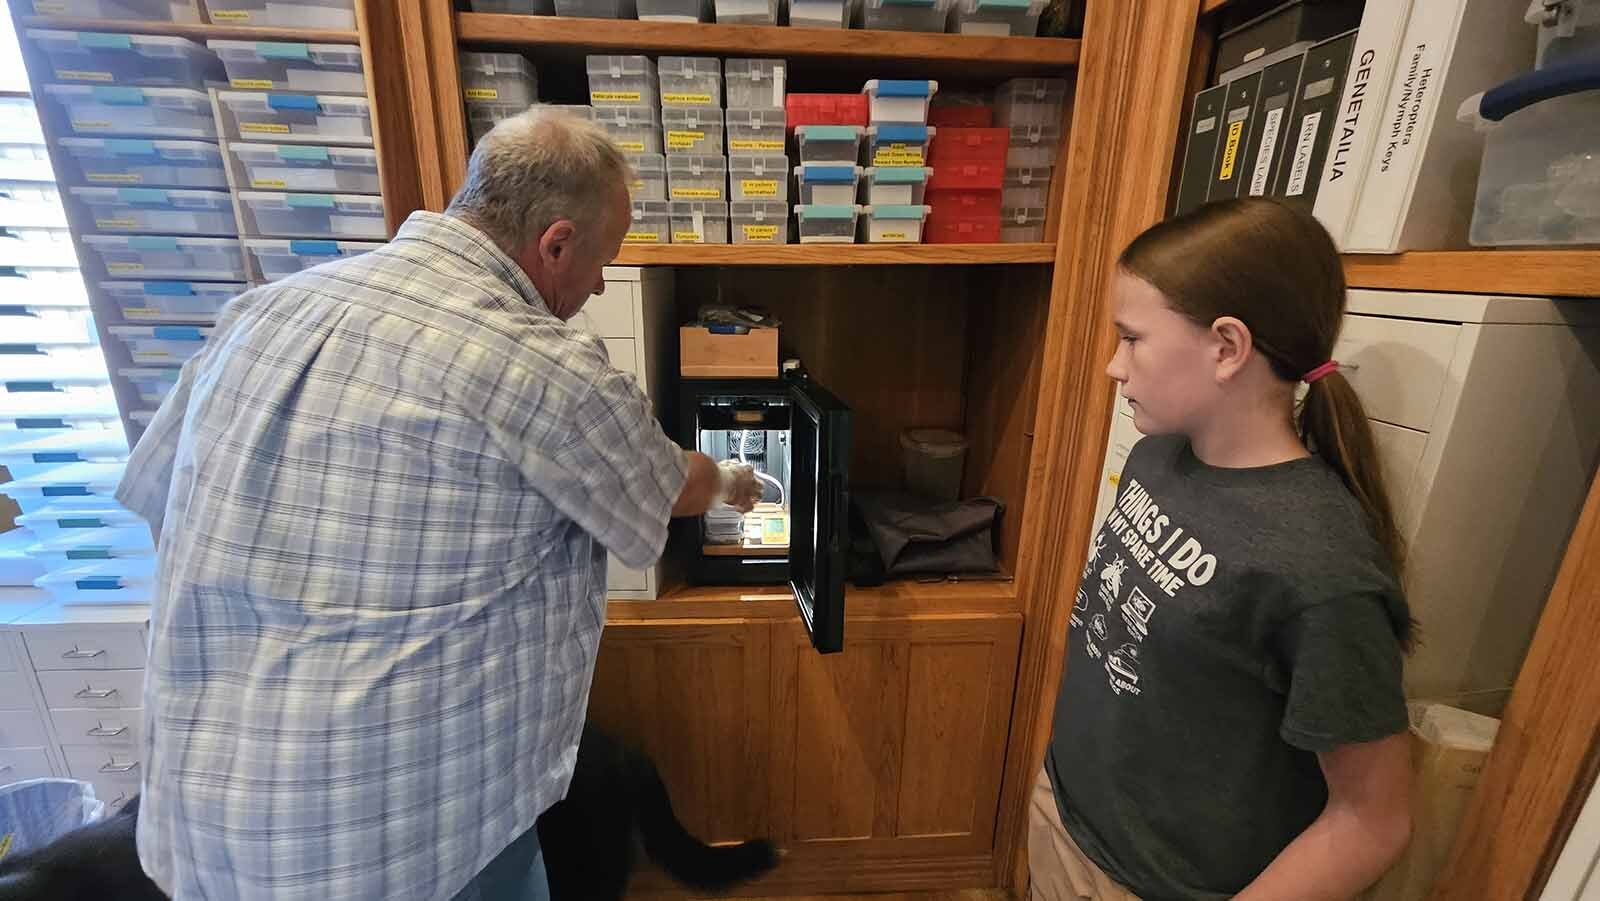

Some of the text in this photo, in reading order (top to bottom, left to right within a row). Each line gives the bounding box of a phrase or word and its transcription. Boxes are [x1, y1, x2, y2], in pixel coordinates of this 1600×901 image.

[1230, 123, 1241, 136] ID
[1260, 112, 1278, 165] SPECIES
[1329, 49, 1375, 182] GENETAILIA
[1381, 44, 1426, 173] Family/Nymph Keys
[1402, 68, 1433, 145] Heteroptera
[1225, 139, 1237, 169] Book
[1290, 143, 1308, 193] LABELS
[1110, 515, 1131, 536] MY
[1121, 528, 1155, 568] SPARE
[1146, 558, 1185, 597] TIME
[1118, 478, 1217, 586] THINGS I DO
[1115, 678, 1142, 695] ABOUT
